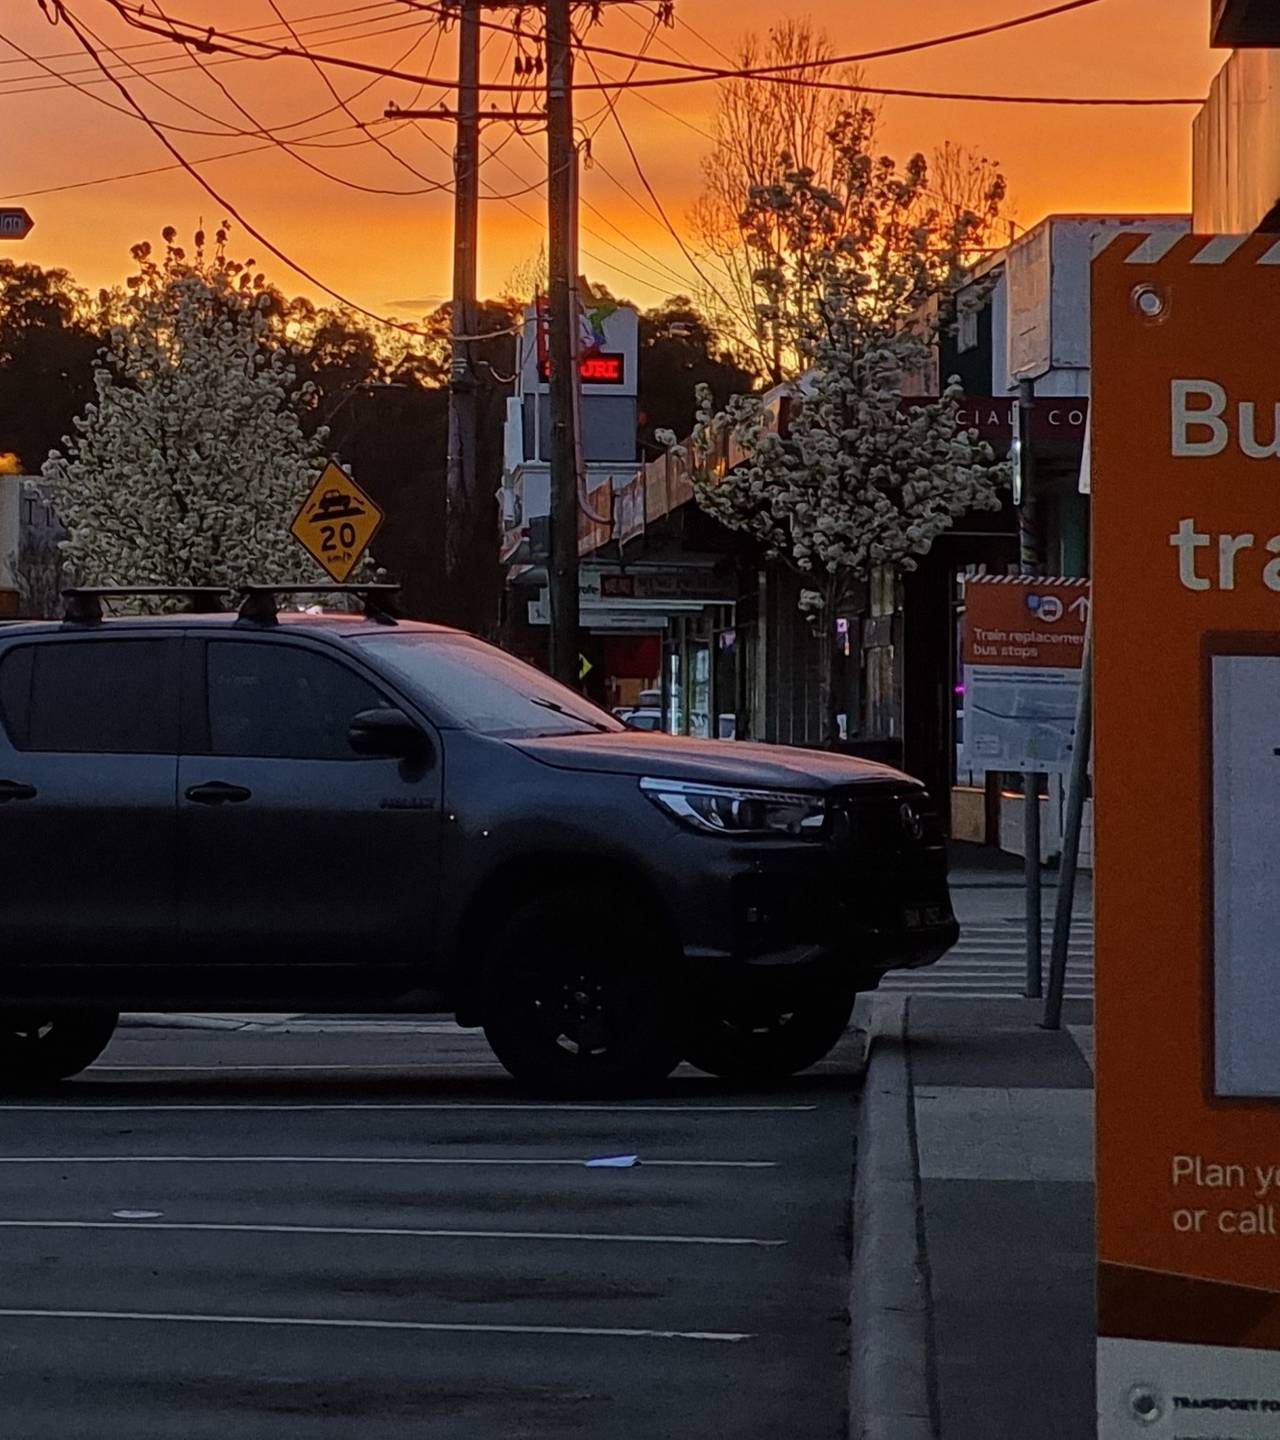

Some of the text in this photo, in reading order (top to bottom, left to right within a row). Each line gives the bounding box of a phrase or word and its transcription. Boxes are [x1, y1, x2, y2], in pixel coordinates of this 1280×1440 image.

[1171, 379, 1280, 458] Bu
[320, 522, 356, 552] 20
[974, 628, 1006, 640] Train
[973, 643, 1038, 658] bus stops
[1173, 1155, 1244, 1187] Plan
[1173, 1203, 1275, 1234] or call
